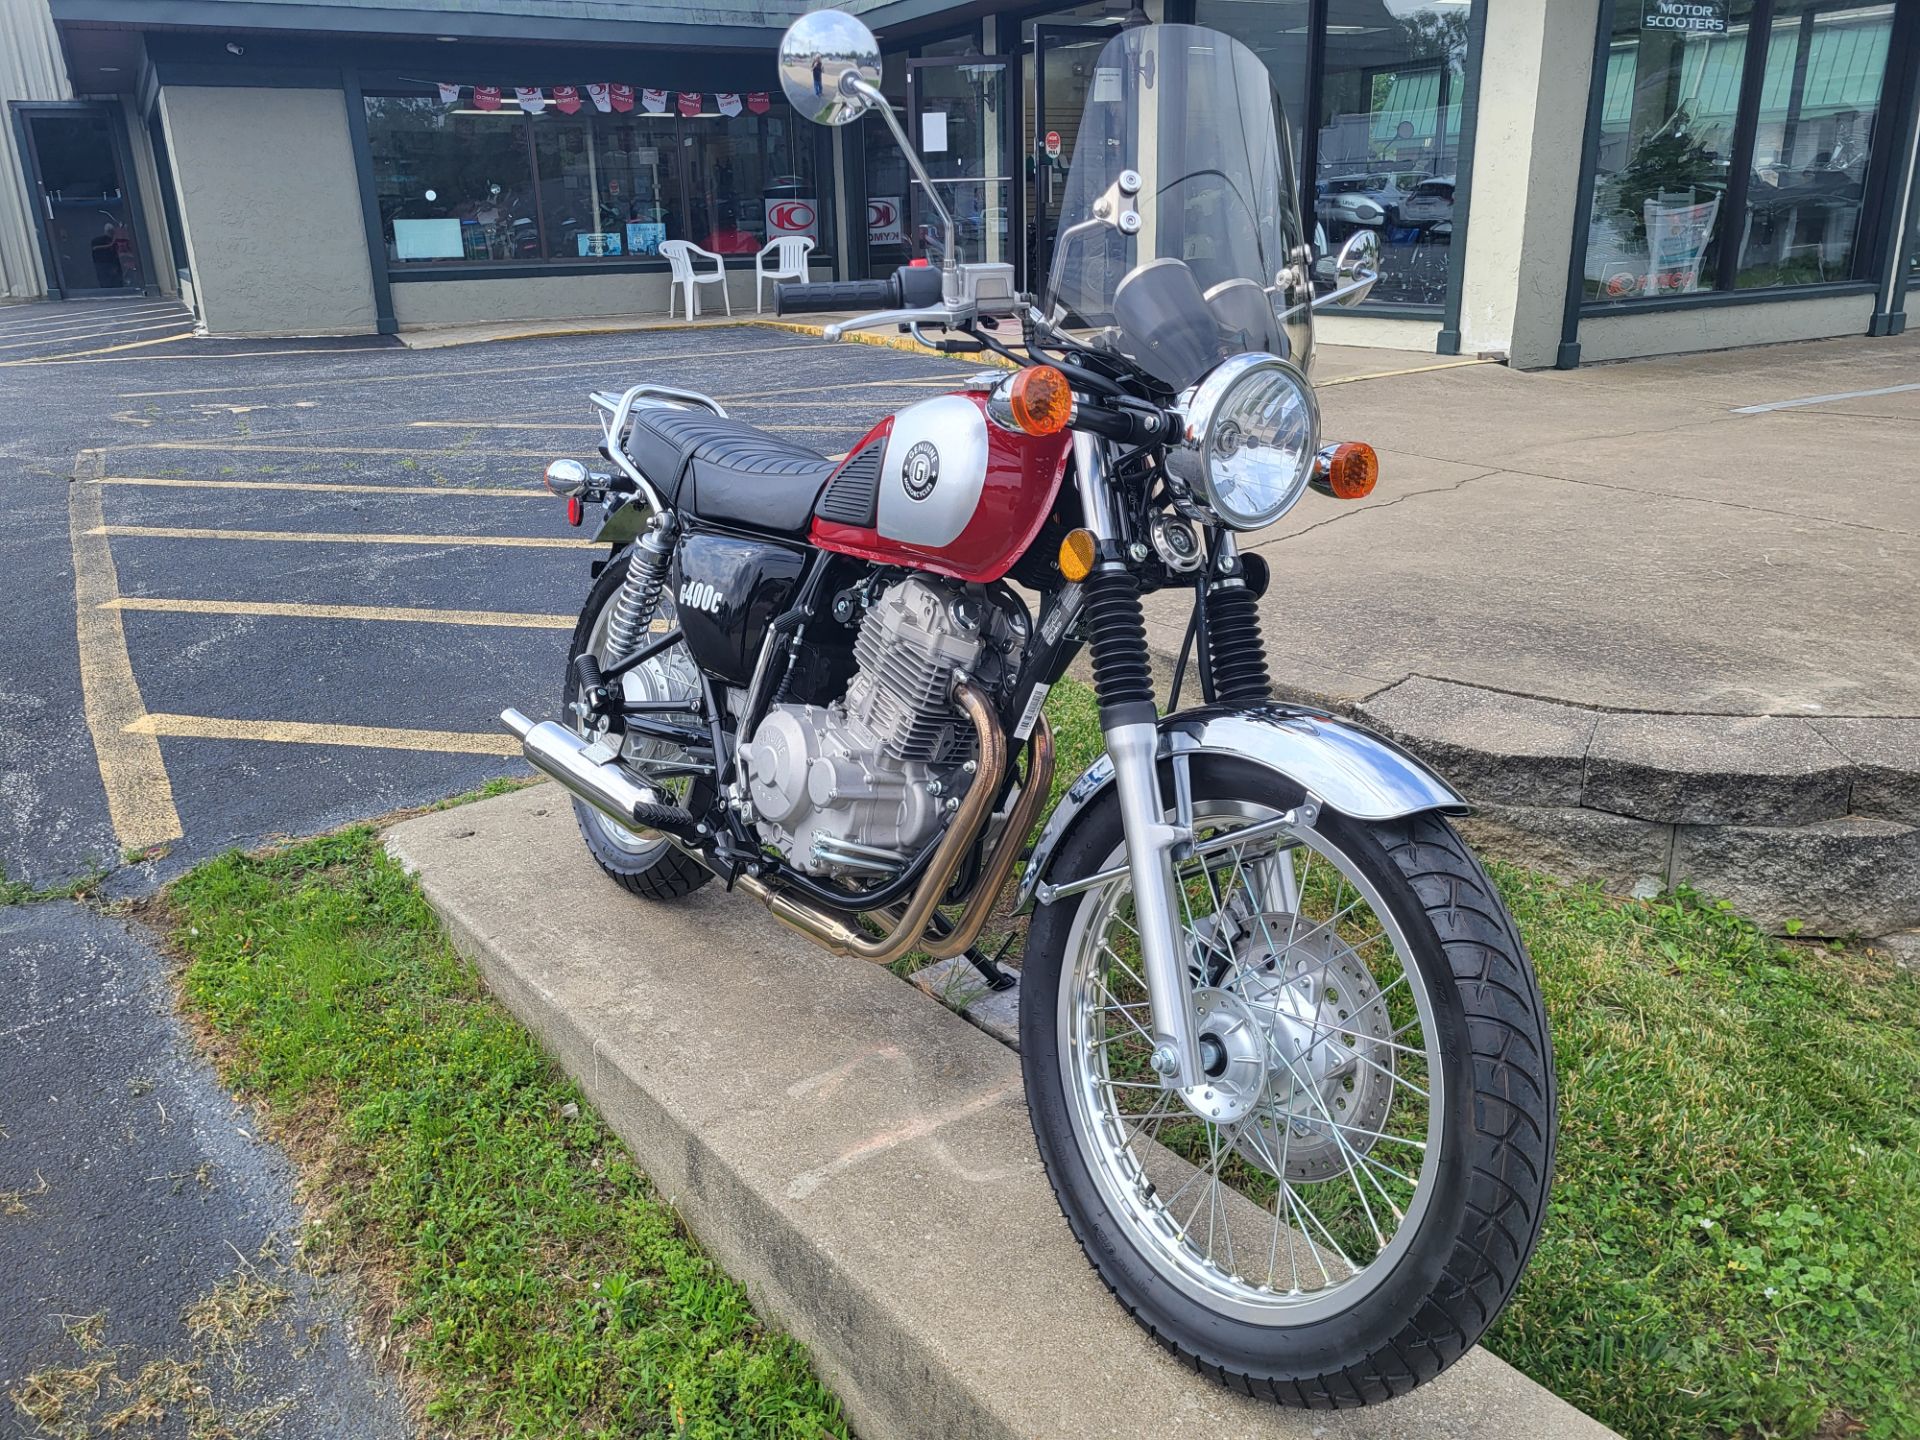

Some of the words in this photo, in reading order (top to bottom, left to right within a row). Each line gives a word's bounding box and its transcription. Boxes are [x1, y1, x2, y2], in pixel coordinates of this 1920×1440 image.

[1660, 3, 1713, 17] MOTOR
[1646, 15, 1725, 31] SCOOTERS
[908, 442, 938, 464] GENUINE
[903, 477, 933, 498] MOTORCYCLES
